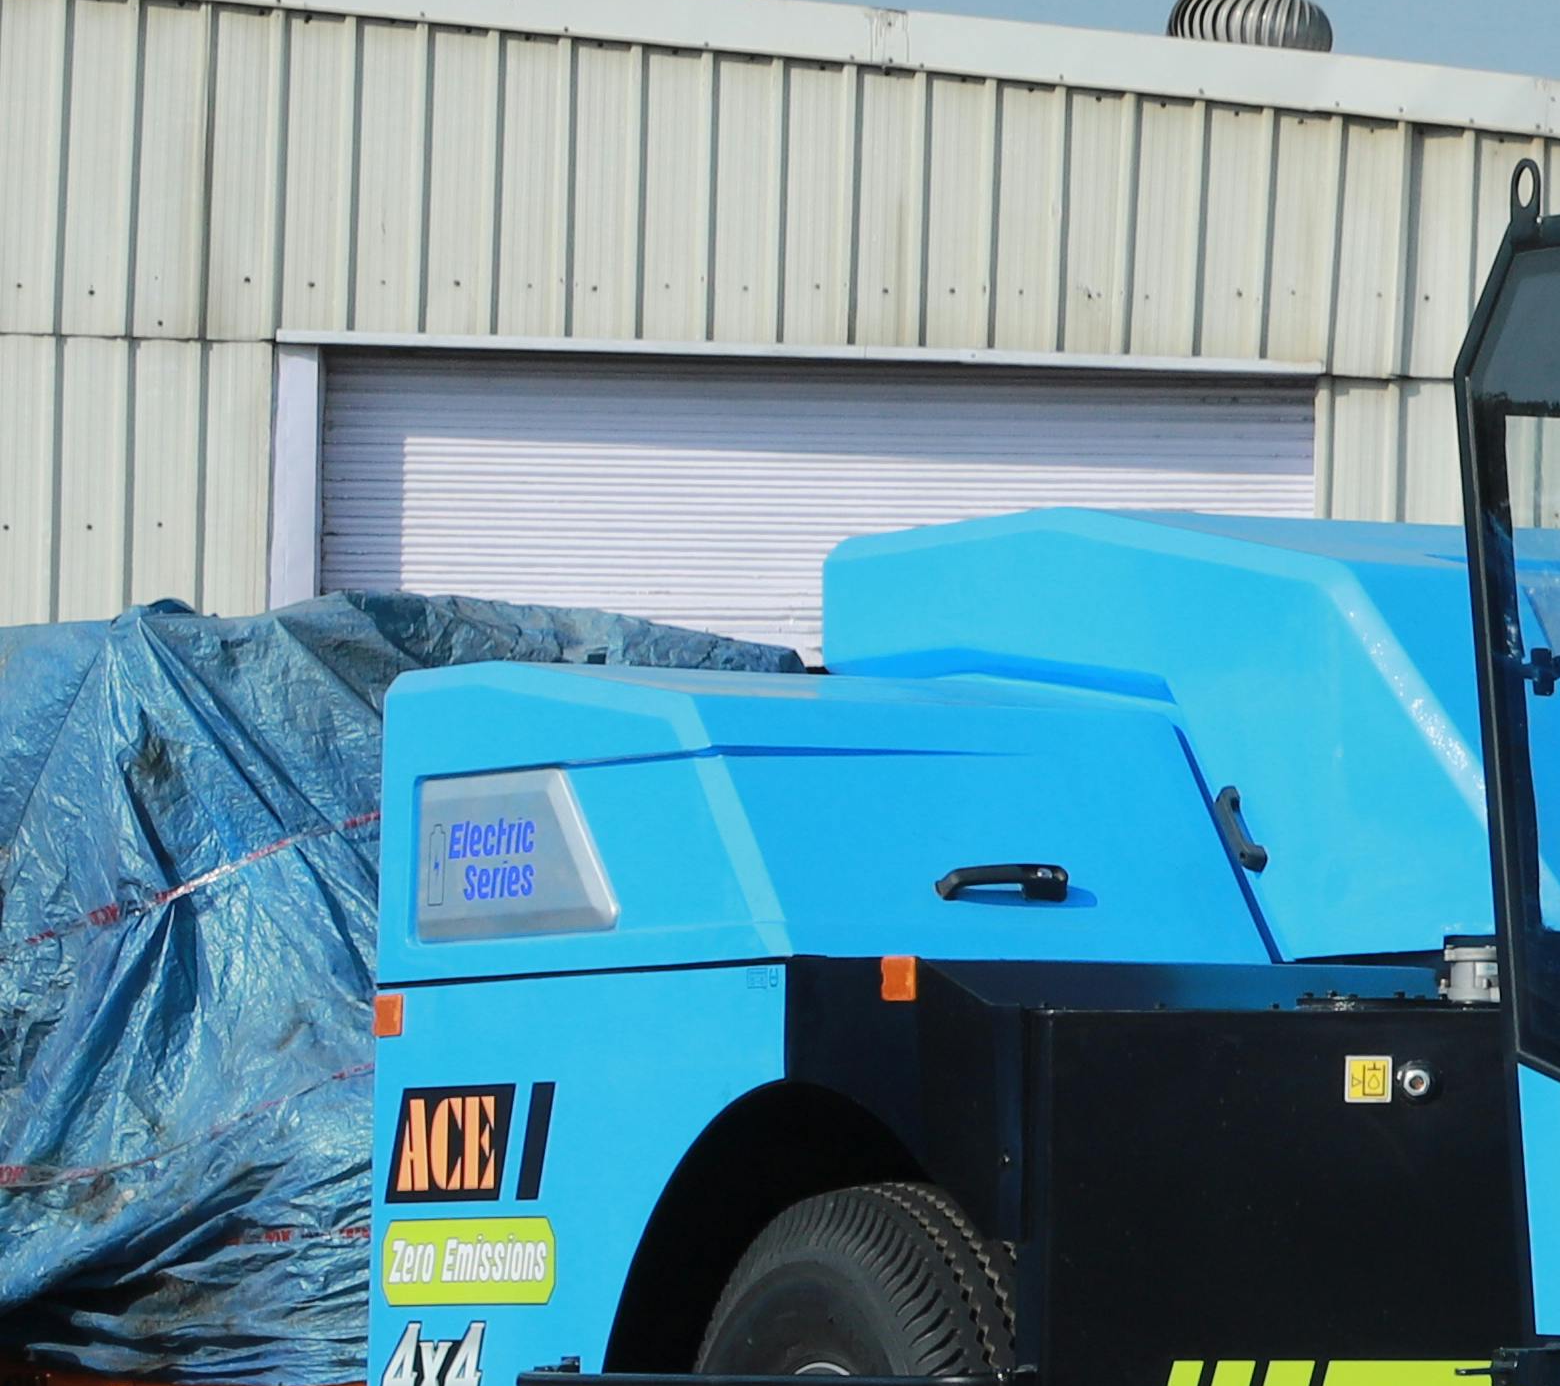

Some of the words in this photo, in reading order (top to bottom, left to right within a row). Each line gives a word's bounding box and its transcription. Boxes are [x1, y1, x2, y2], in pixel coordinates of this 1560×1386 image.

[448, 817, 536, 860] Electric
[463, 860, 535, 902] Series
[397, 1096, 495, 1191] ACE
[387, 1239, 436, 1285] Zero
[440, 1235, 548, 1284] Emissions
